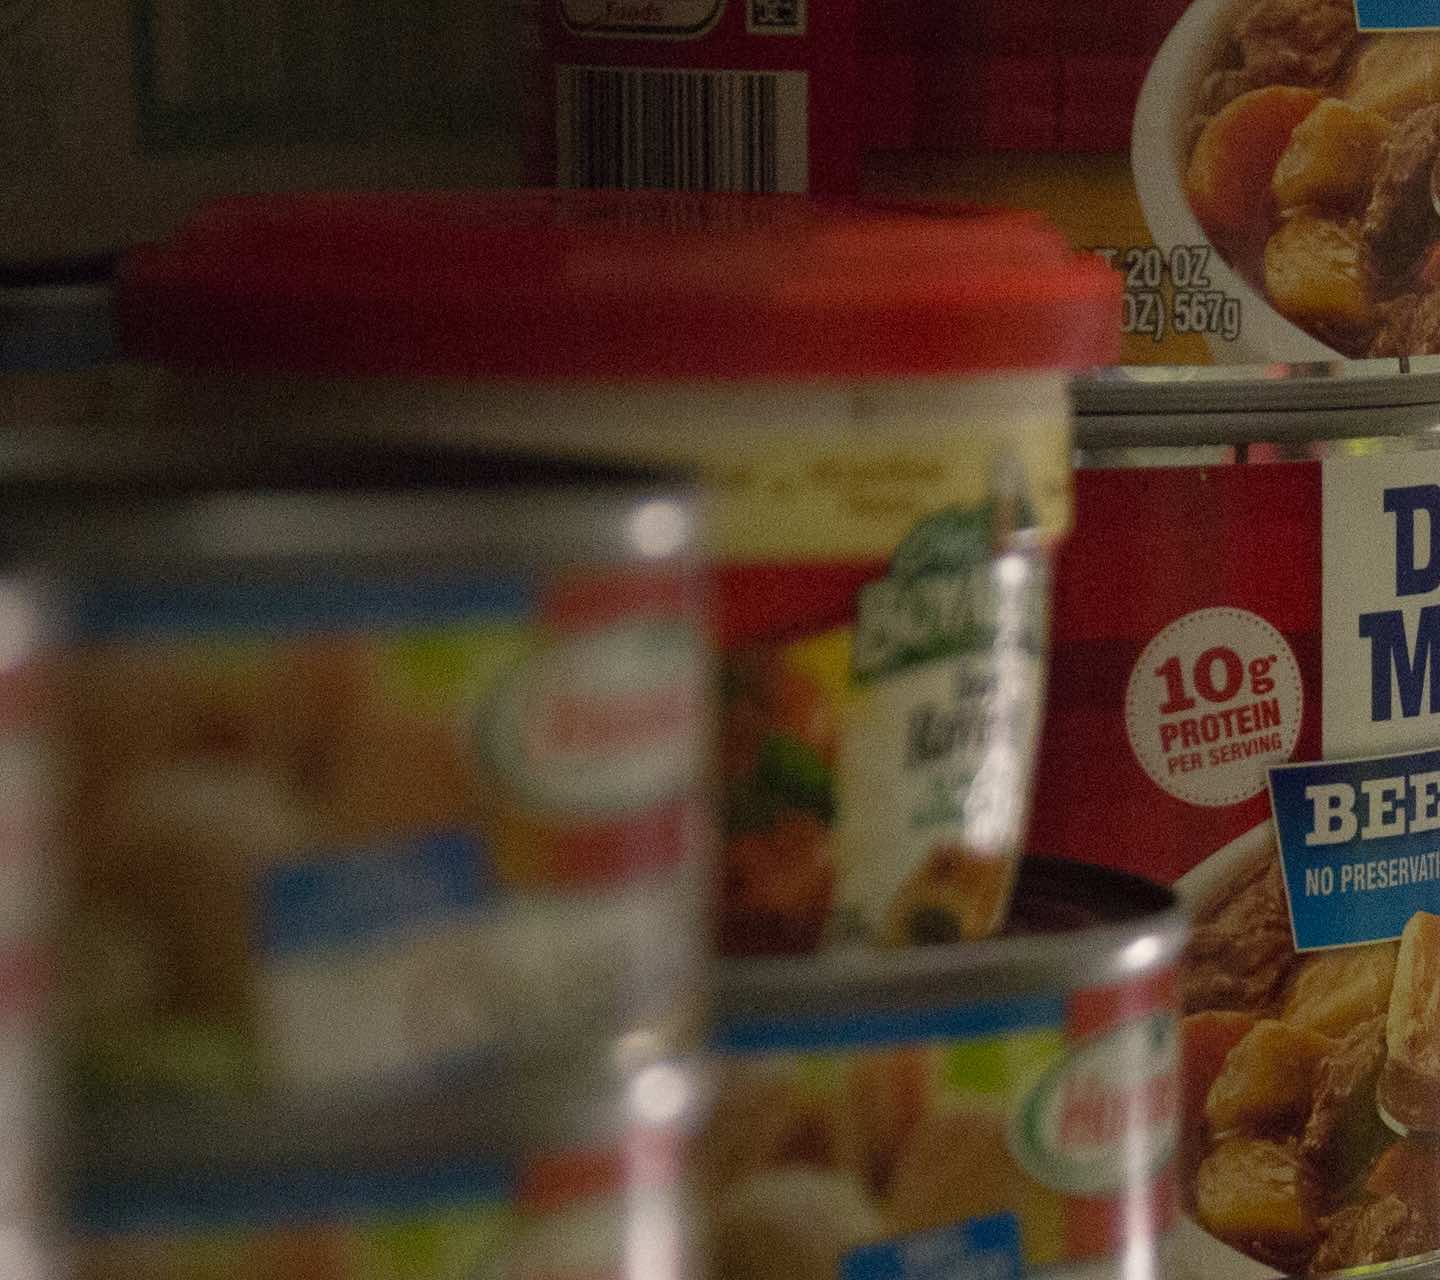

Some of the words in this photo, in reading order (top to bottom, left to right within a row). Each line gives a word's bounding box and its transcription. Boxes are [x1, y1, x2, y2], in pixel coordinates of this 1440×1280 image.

[1124, 246, 1162, 289] 20
[1170, 245, 1212, 289] OZ
[1173, 290, 1242, 342] 567g
[1153, 644, 1279, 716] 10g
[1158, 696, 1283, 755] PROTEIN
[1166, 751, 1205, 777] PER
[1206, 730, 1284, 768] SERVING
[1303, 865, 1335, 898] NO
